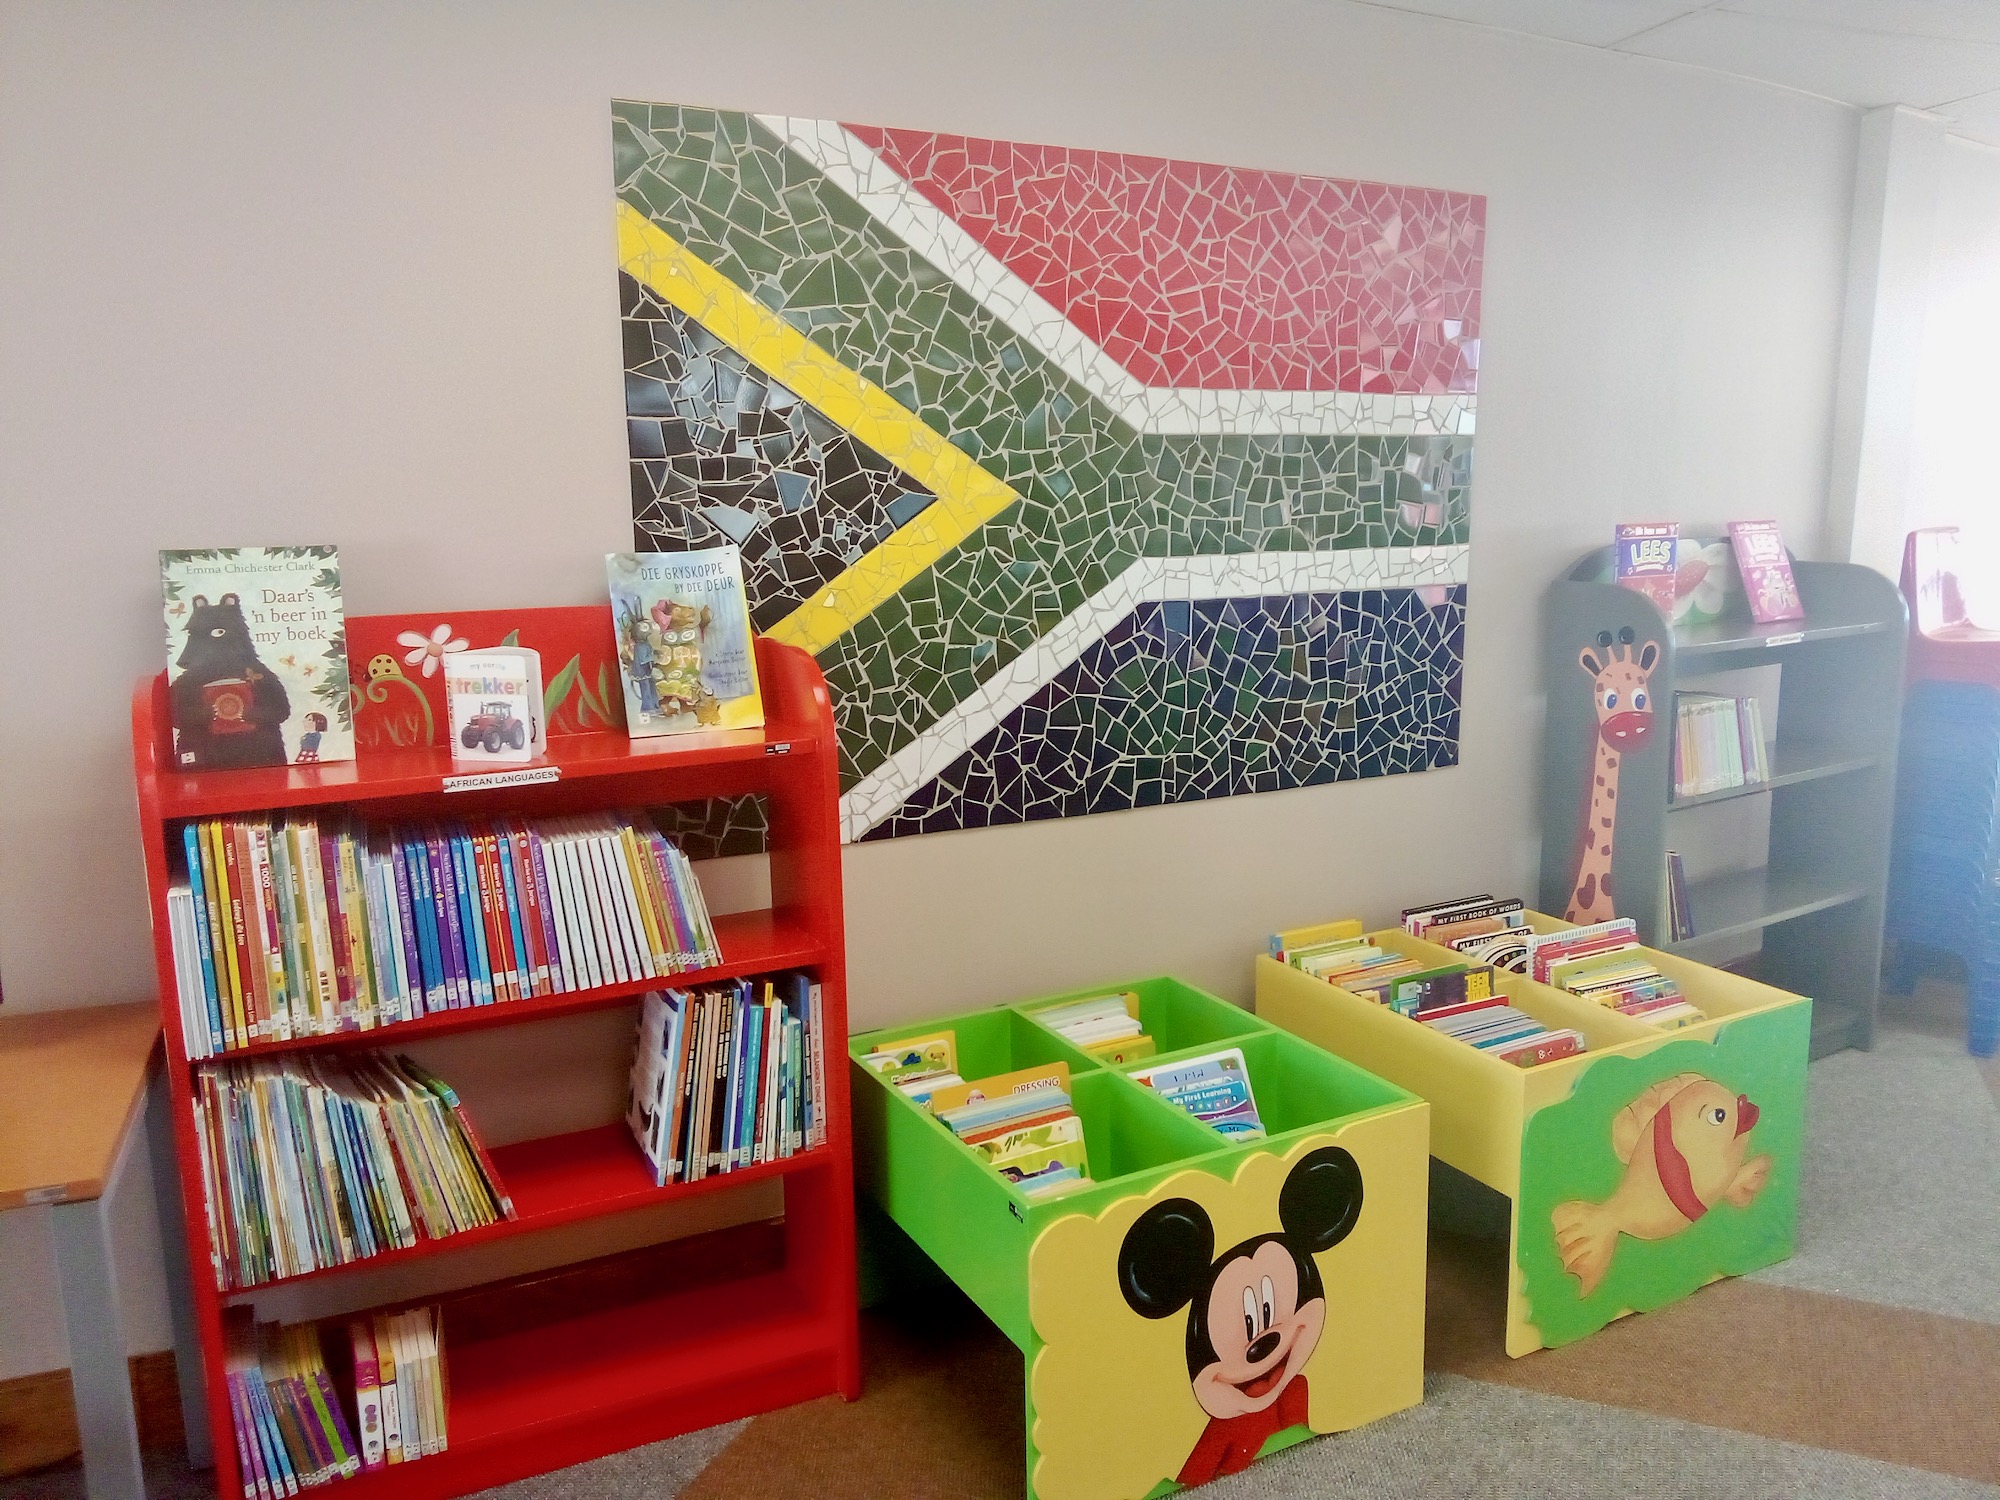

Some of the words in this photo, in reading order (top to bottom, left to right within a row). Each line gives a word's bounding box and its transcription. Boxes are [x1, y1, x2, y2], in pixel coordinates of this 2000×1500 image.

[1631, 540, 1671, 565] LEES
[1744, 533, 1779, 555] LEES
[186, 566, 221, 574] Emma
[225, 563, 282, 573] Chichester
[286, 561, 315, 571] Clark
[641, 568, 661, 580] DIE
[665, 562, 724, 580] GRYSKOPPE
[675, 583, 684, 593] BY
[687, 582, 702, 592] DIE
[707, 576, 735, 591] DEUR
[262, 589, 314, 604] Daar's
[271, 608, 306, 622] beer
[312, 607, 327, 620] in
[256, 631, 280, 644] my
[287, 626, 327, 640] boek
[456, 676, 523, 695] trekker
[449, 778, 492, 788] AFRICAN
[495, 771, 554, 784] LANGUAGES
[260, 866, 270, 888] 1000
[1450, 914, 1467, 923] FIRST
[1469, 910, 1487, 919] BOOK
[1499, 903, 1520, 913] WORDS
[1173, 1097, 1184, 1105] My
[1184, 1092, 1201, 1101] First
[1202, 1087, 1232, 1098] Learning
